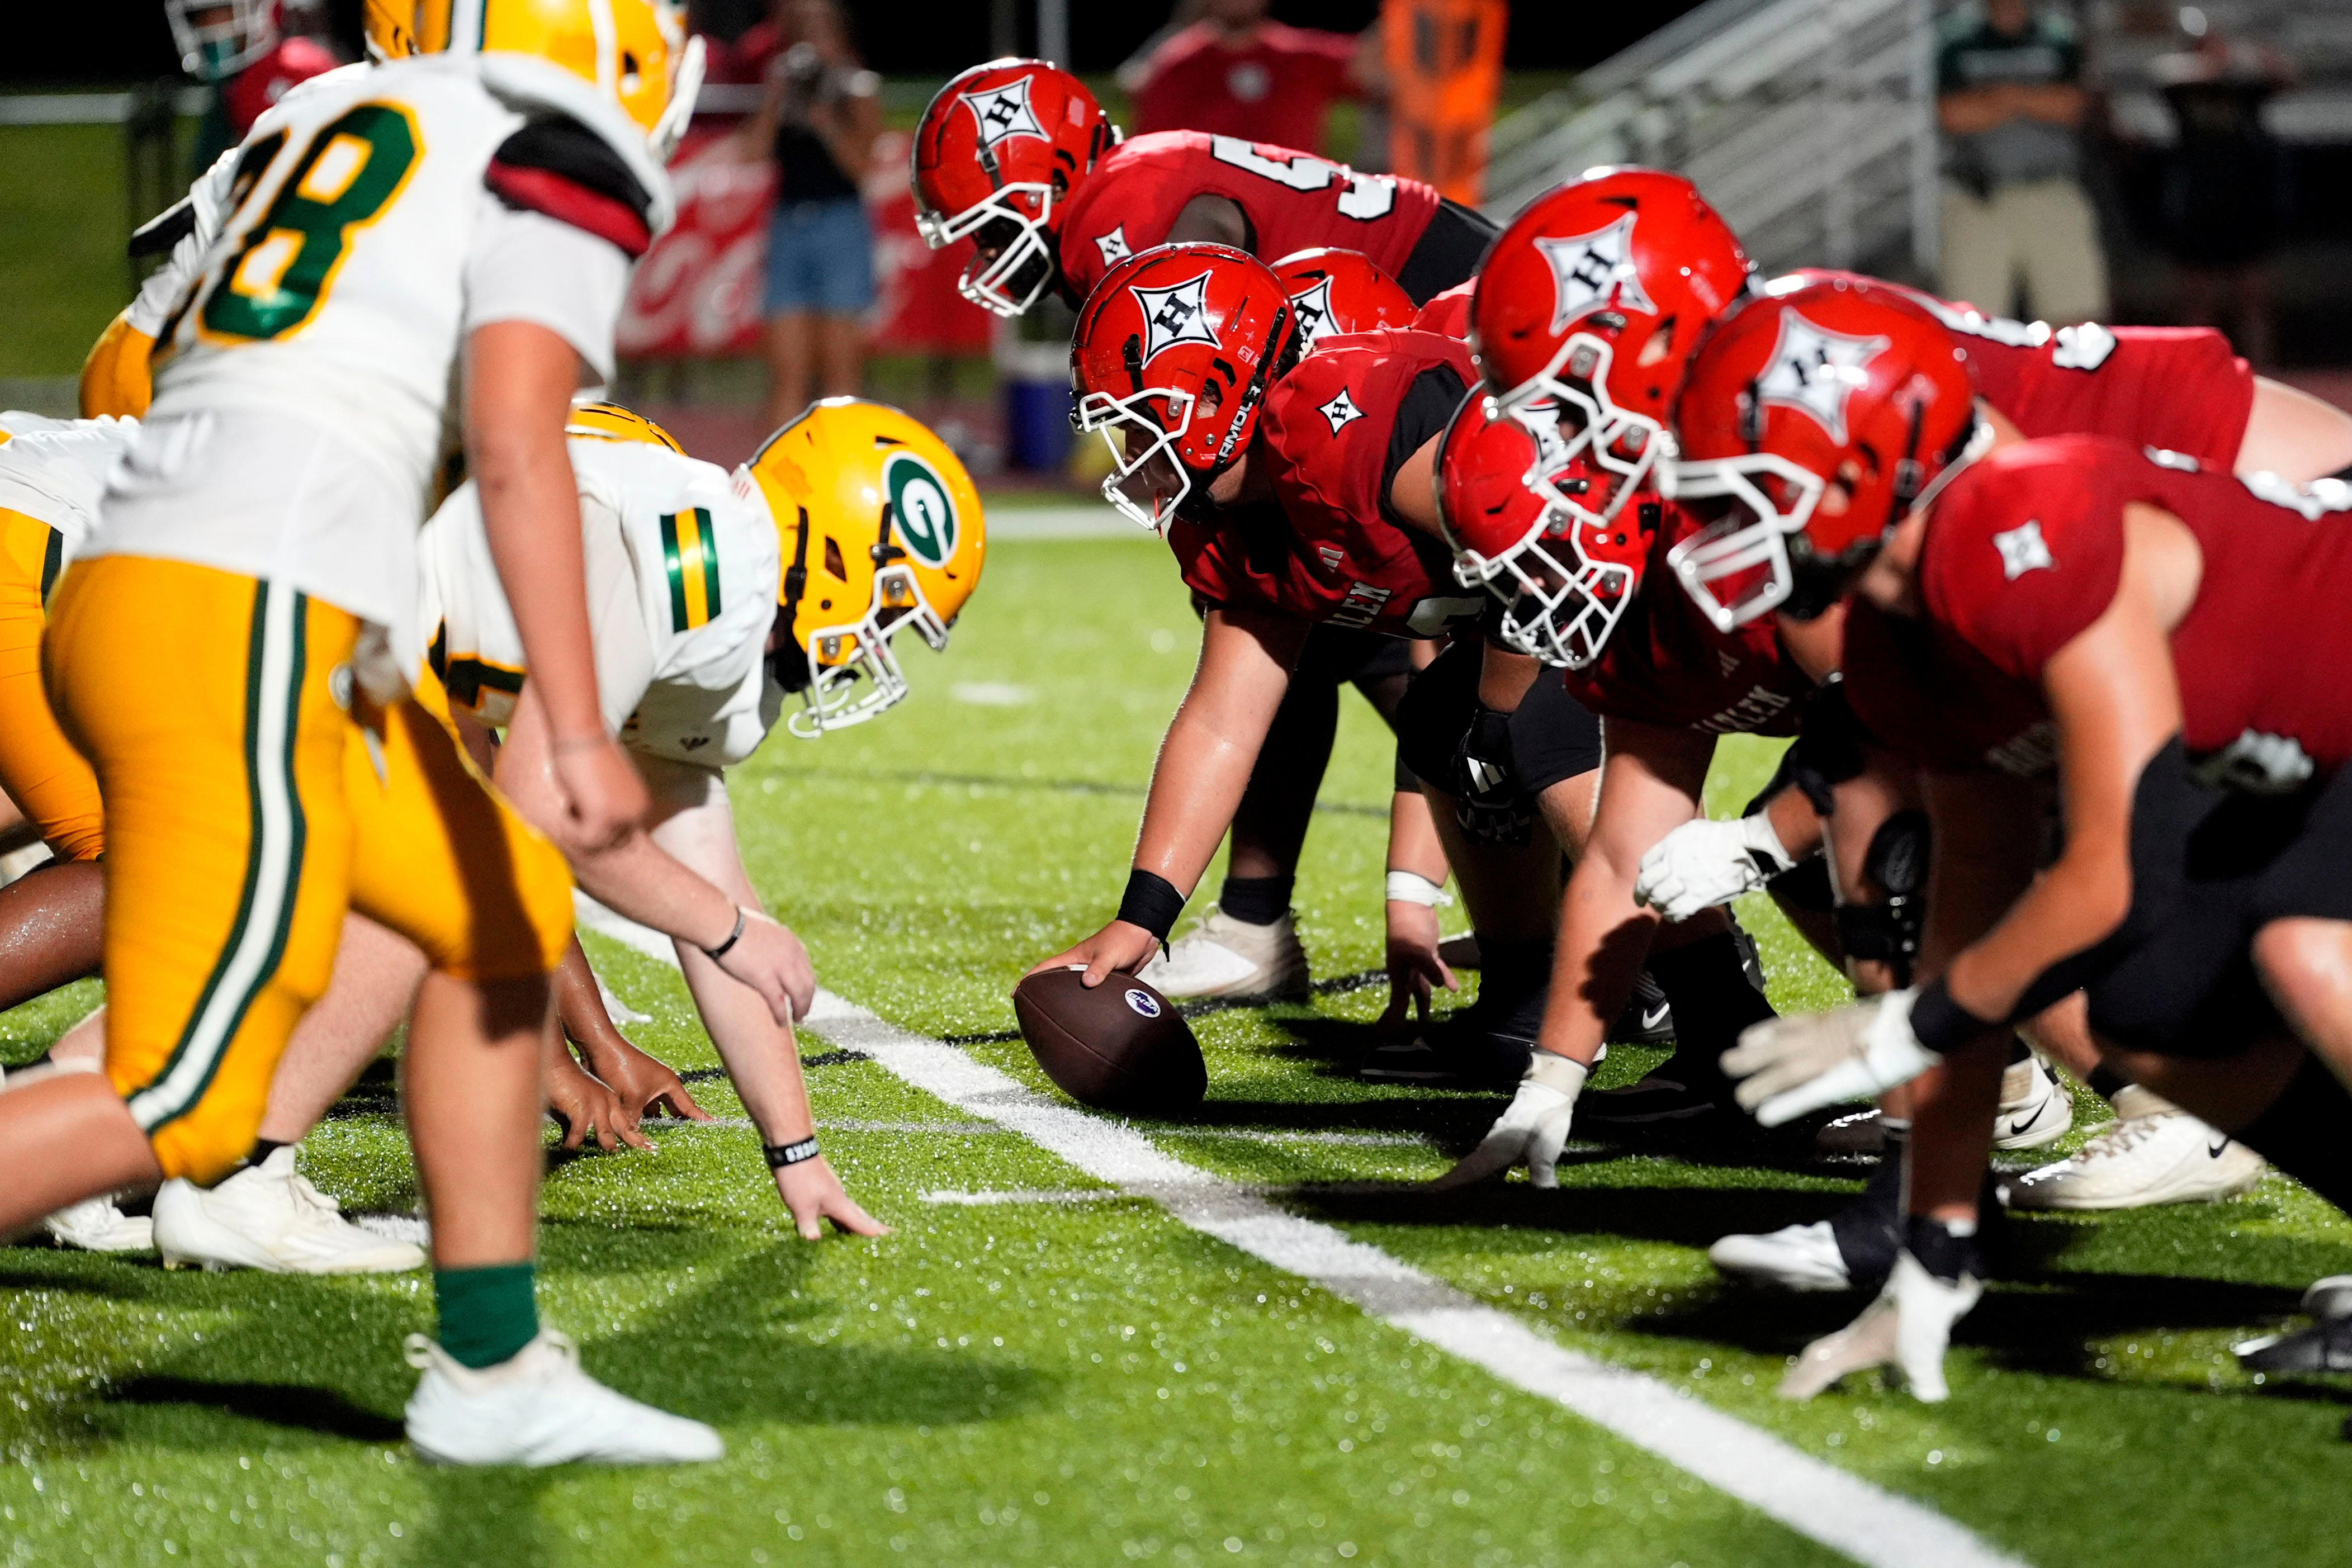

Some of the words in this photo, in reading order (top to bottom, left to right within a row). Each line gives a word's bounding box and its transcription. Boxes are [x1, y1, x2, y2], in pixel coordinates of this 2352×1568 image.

[984, 93, 1021, 129] H
[1104, 238, 1121, 256] H
[1569, 248, 1616, 293] H
[1152, 292, 1197, 338] H
[1331, 401, 1349, 421] H
[886, 456, 957, 565] G
